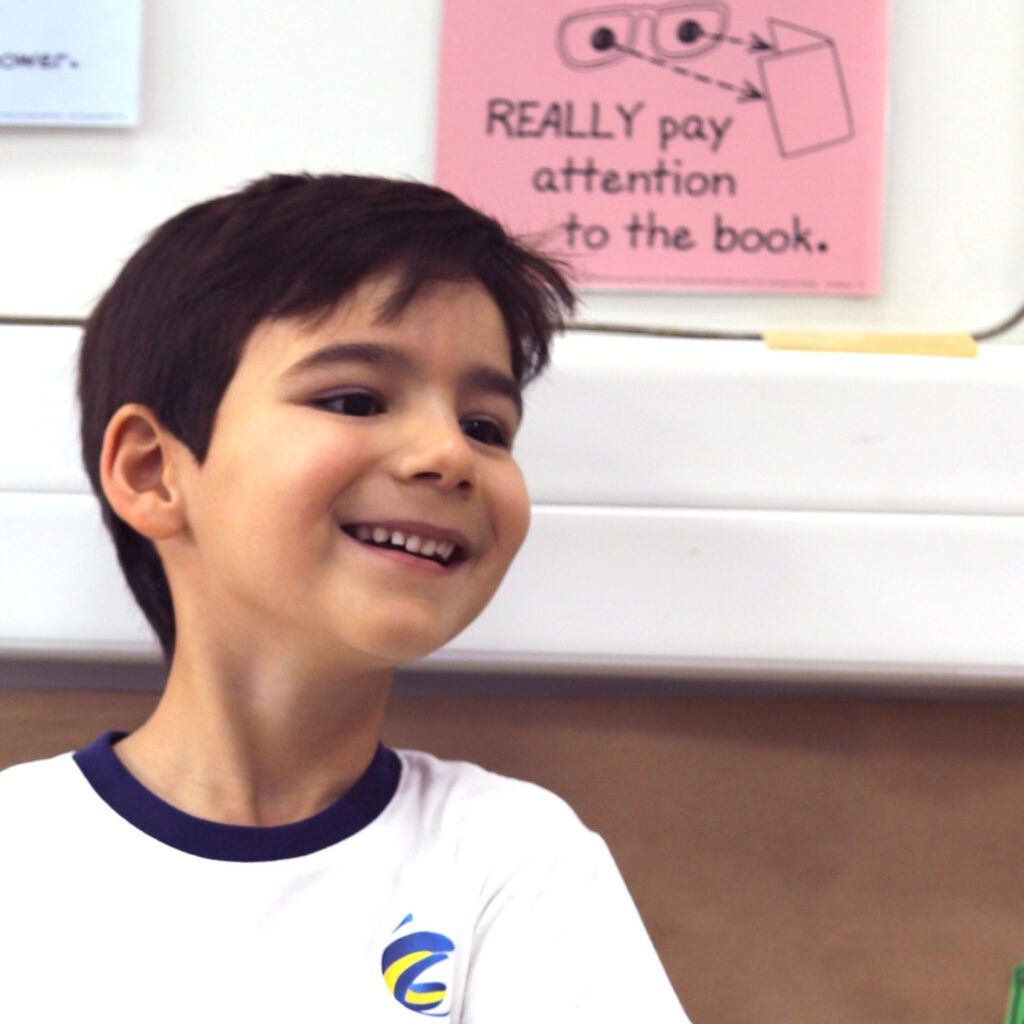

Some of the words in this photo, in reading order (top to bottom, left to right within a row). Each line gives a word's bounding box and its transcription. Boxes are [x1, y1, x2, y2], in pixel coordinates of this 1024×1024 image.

[486, 98, 643, 139] REALLY
[659, 114, 733, 151] pay
[533, 158, 736, 197] attention
[563, 213, 609, 250] to
[625, 212, 695, 251] the
[714, 214, 829, 254] book.
